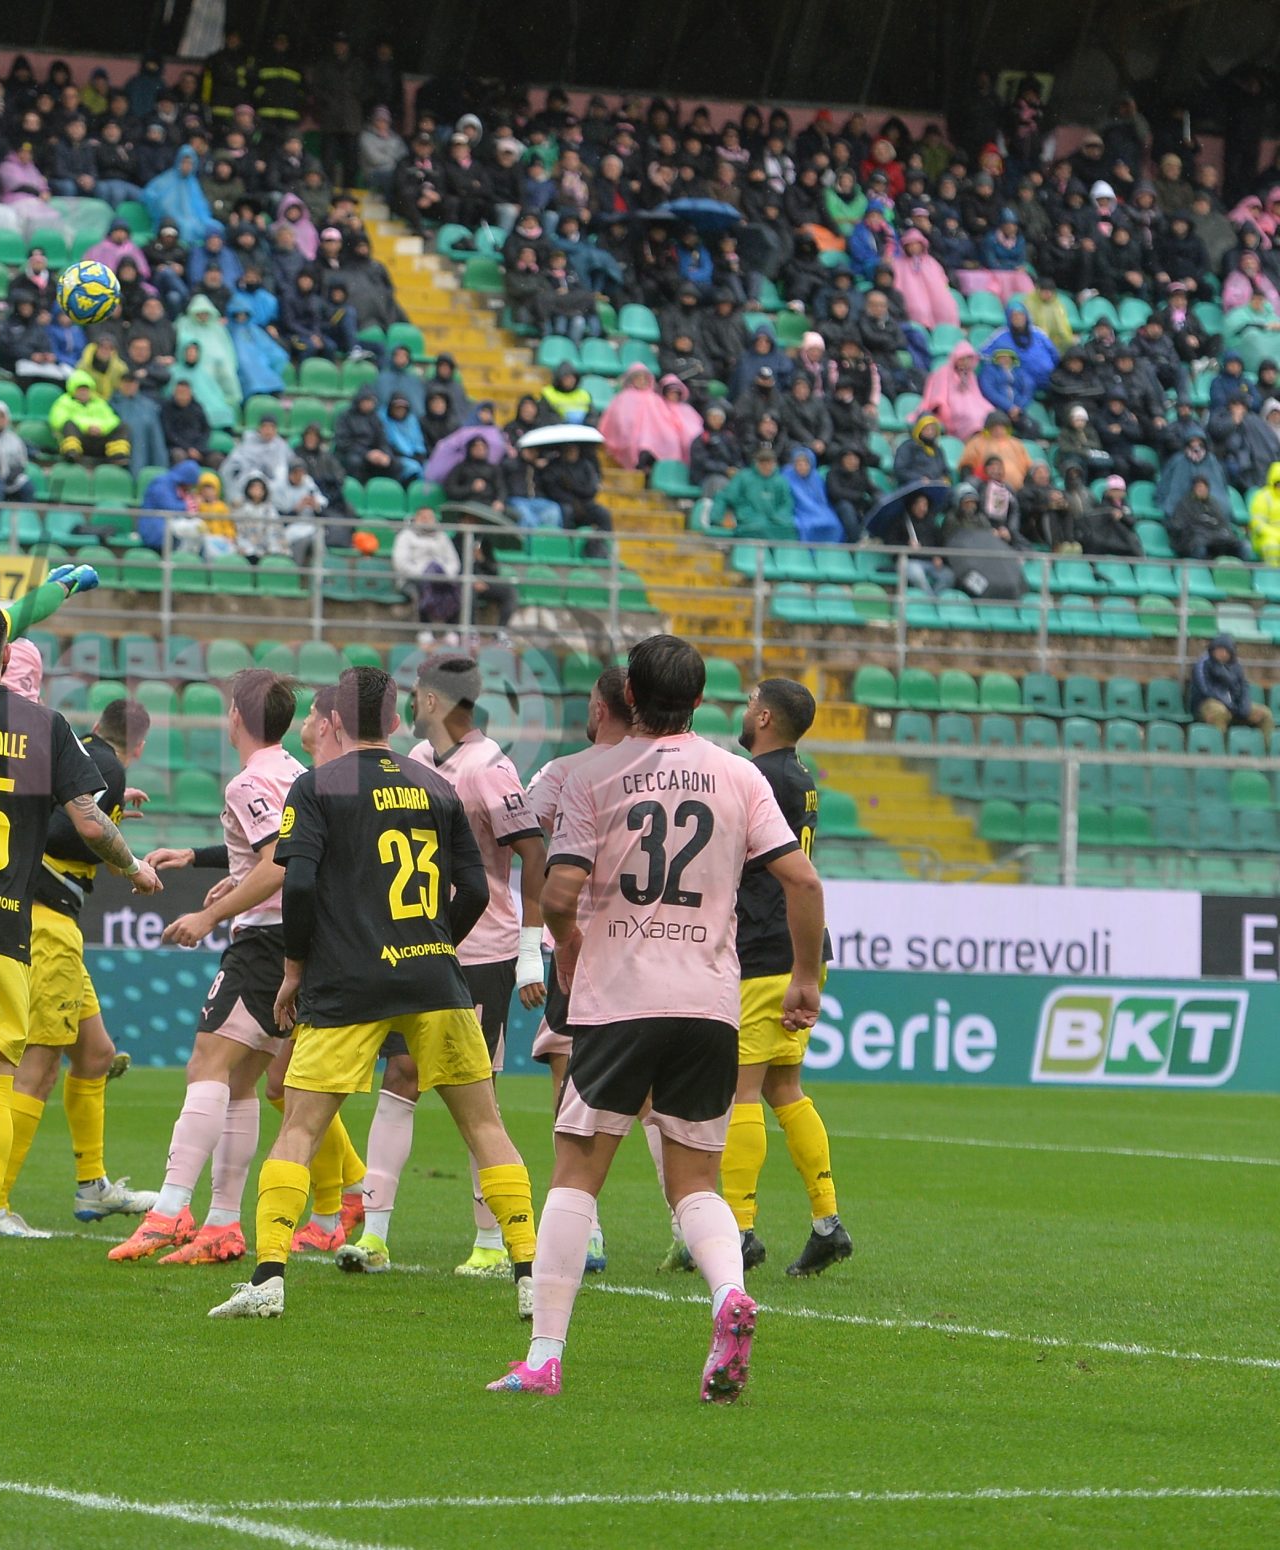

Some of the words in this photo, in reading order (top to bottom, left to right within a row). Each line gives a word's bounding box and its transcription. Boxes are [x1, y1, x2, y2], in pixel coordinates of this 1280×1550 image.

[372, 786, 430, 812] CALDARA
[622, 769, 716, 795] CECCARONI
[377, 827, 440, 921] 23
[619, 799, 715, 909] 32
[102, 907, 164, 949] rte
[838, 928, 892, 969] rte
[906, 929, 1112, 975] scorrevoli
[207, 970, 226, 1000] 8
[802, 992, 999, 1073] Serie
[1046, 1007, 1233, 1064] BKT
